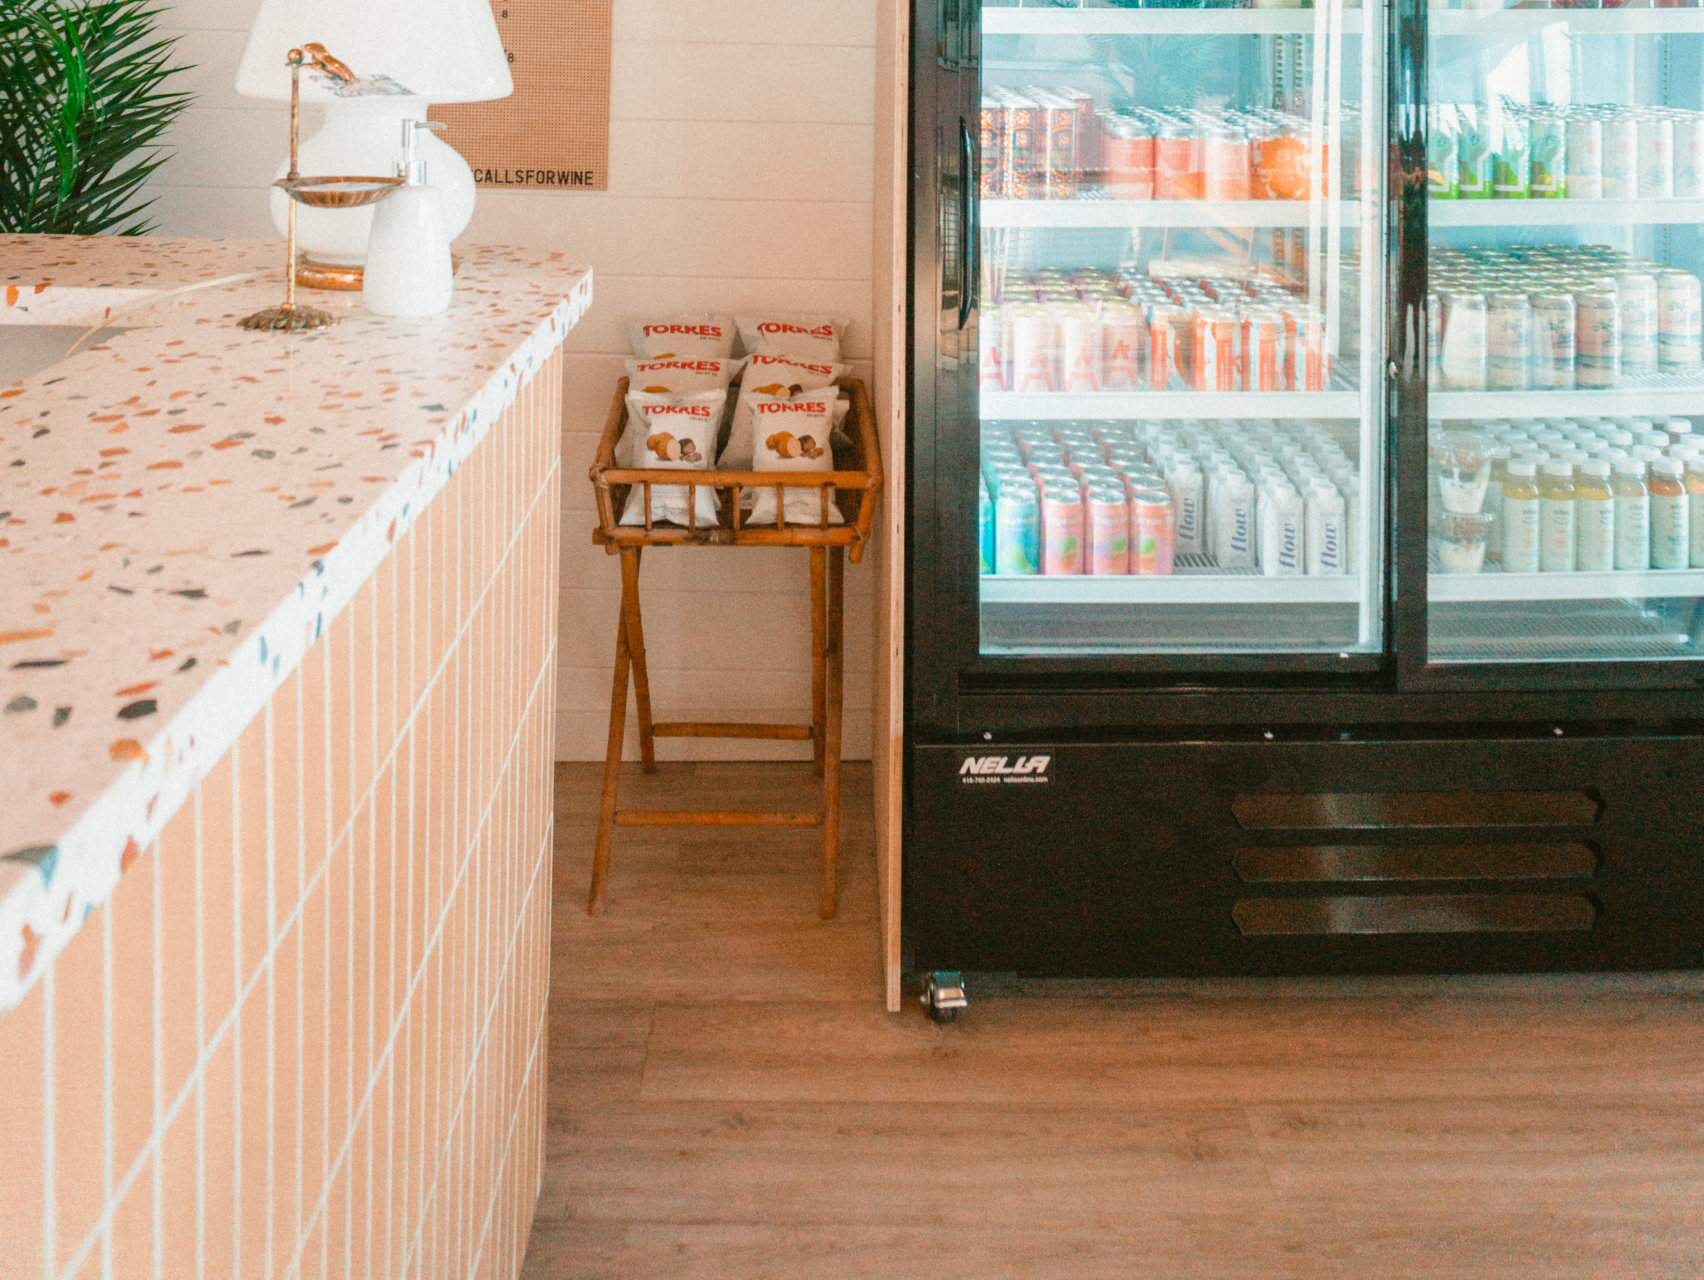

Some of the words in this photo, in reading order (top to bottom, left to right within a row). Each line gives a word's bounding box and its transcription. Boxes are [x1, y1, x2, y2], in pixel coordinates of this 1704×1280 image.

[471, 168, 594, 186] CALLSFORWINE
[643, 324, 722, 337] TORRES
[757, 323, 833, 337] TORRES
[637, 361, 721, 372] TORRES
[642, 405, 711, 417] TORRES
[757, 402, 826, 414] TORRES
[1179, 498, 1195, 541] flow
[1231, 508, 1247, 552] flow
[1279, 523, 1296, 568] flow
[1321, 523, 1337, 568] flow
[959, 755, 1051, 775] NELLA
